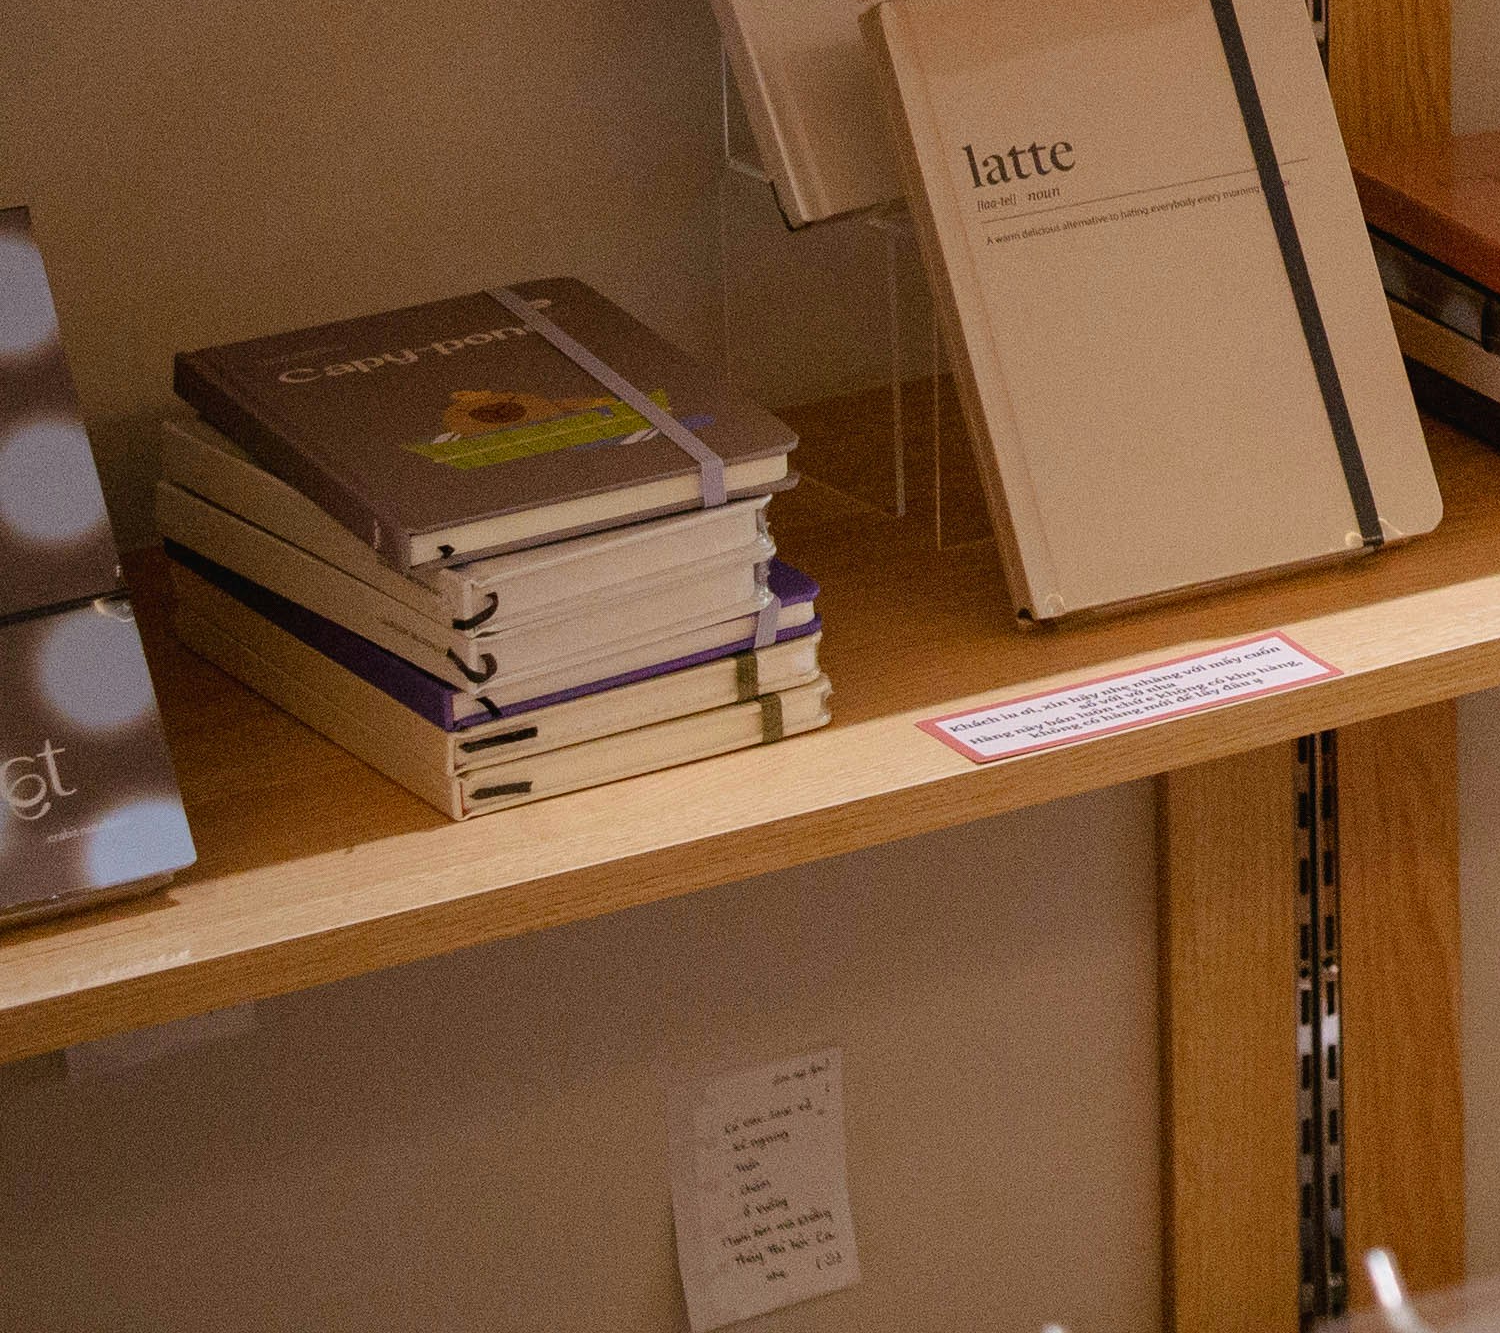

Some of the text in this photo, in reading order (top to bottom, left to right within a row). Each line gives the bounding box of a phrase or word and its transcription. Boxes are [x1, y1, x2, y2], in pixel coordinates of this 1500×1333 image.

[961, 140, 1077, 190] latte
[986, 234, 995, 246] A
[996, 230, 1021, 244] warm
[1022, 222, 1062, 241] delicious
[1062, 214, 1108, 232] alternative
[1109, 212, 1120, 224] to
[1120, 205, 1149, 223] hating
[1151, 196, 1197, 216] everybody
[1197, 190, 1221, 207] every
[1027, 185, 1061, 203] noun
